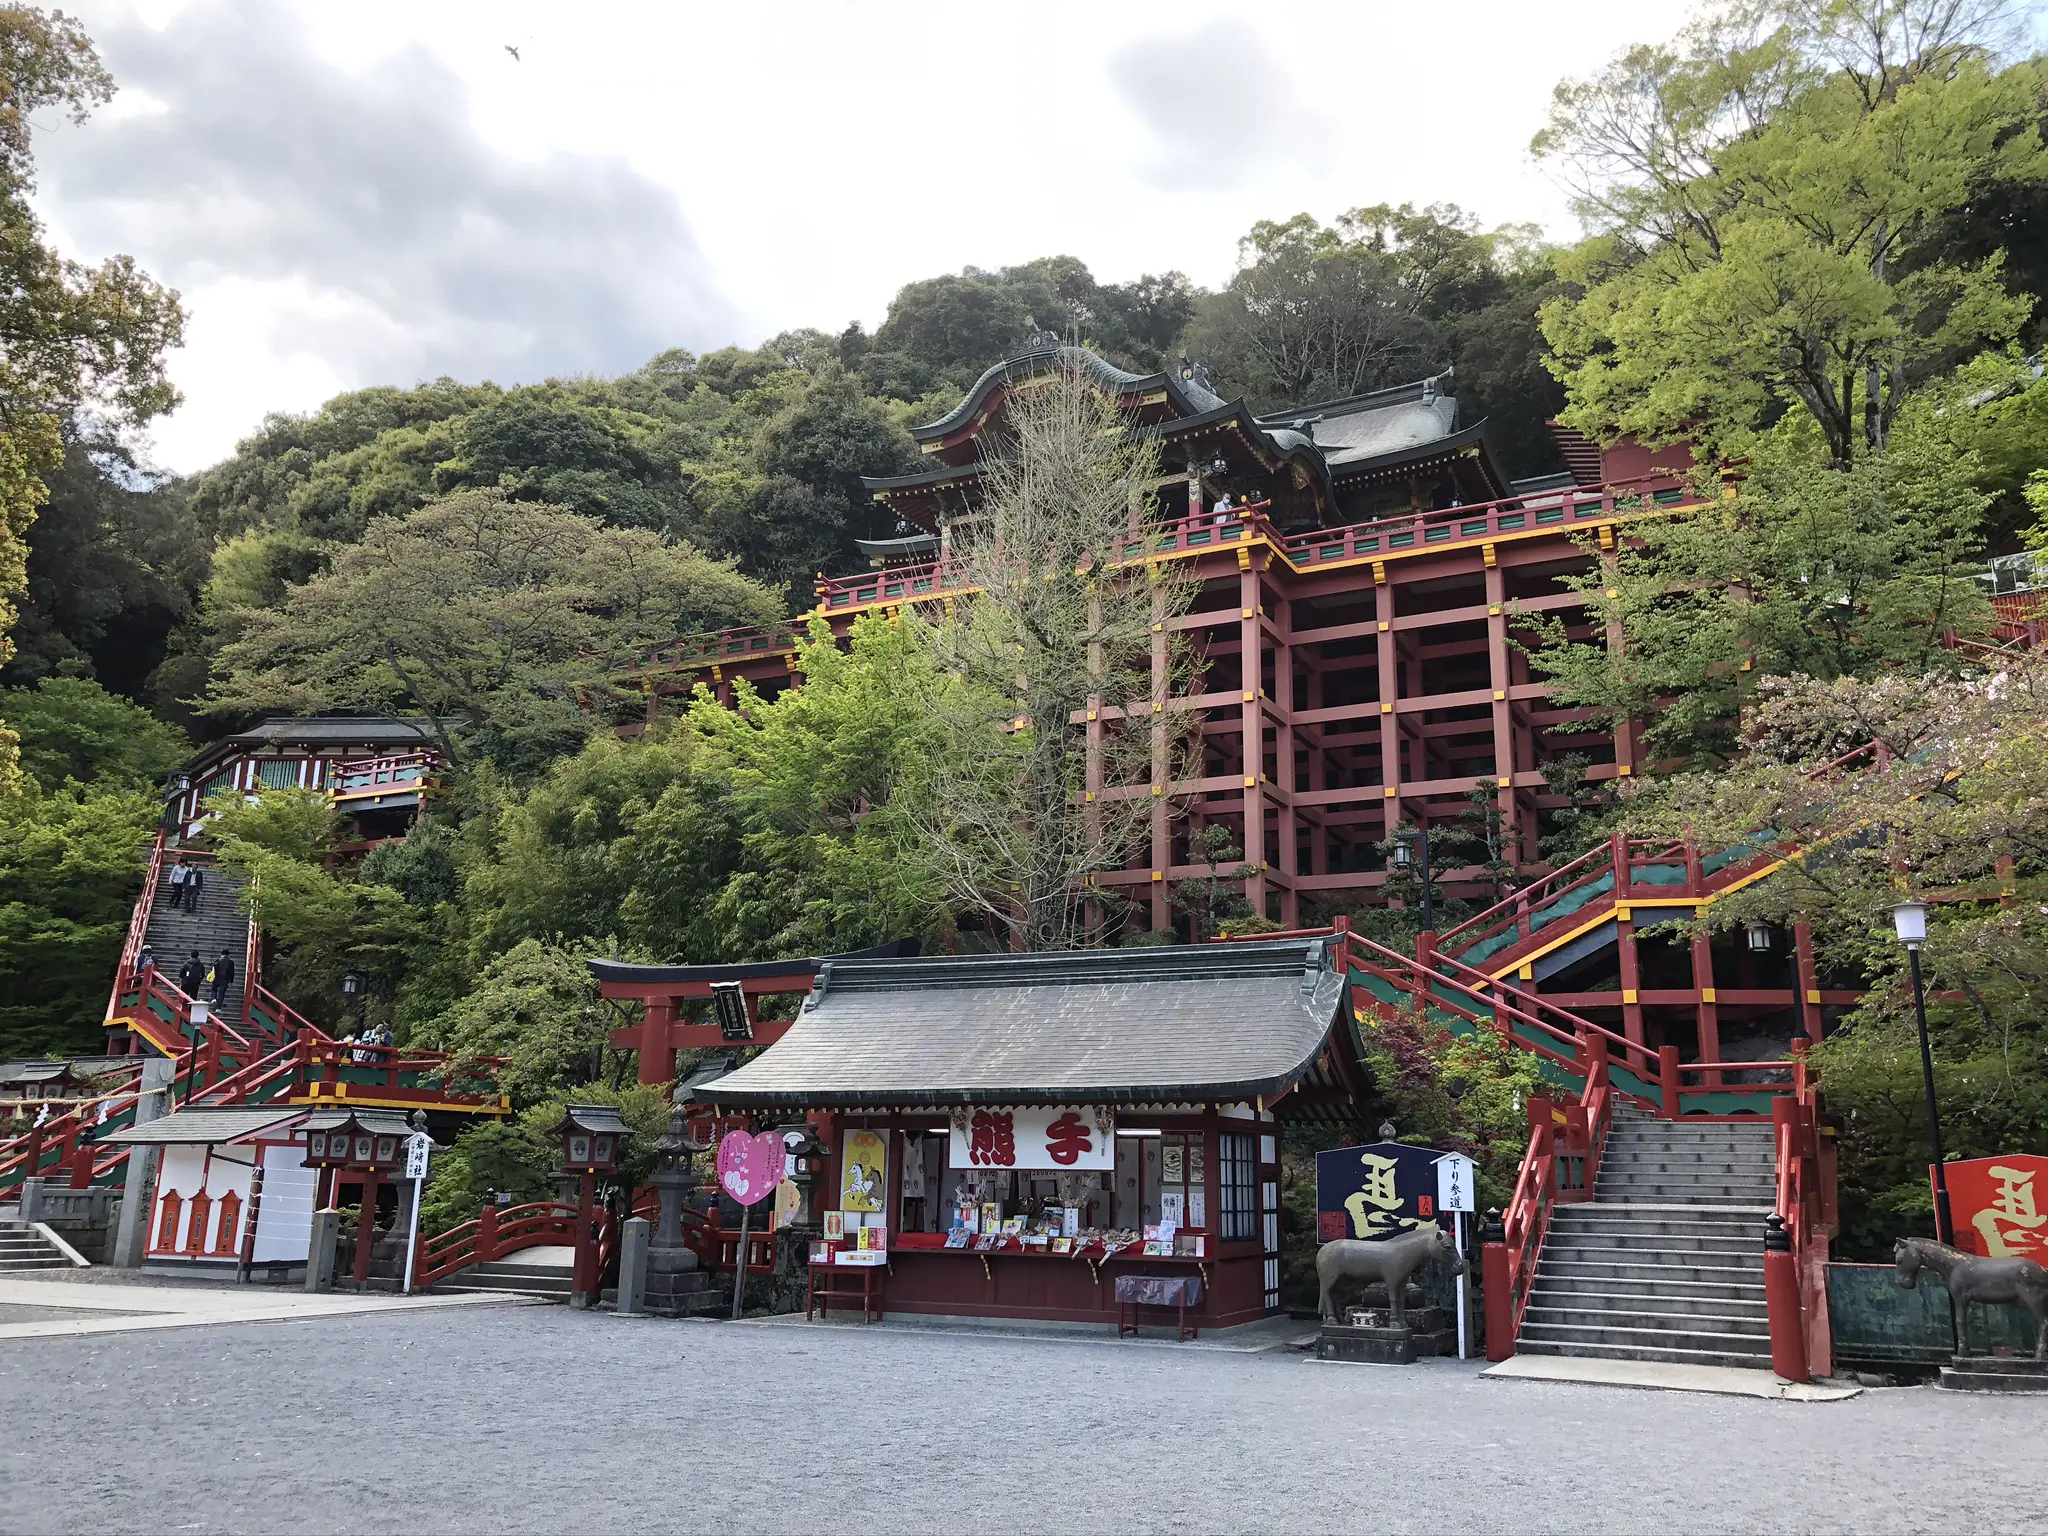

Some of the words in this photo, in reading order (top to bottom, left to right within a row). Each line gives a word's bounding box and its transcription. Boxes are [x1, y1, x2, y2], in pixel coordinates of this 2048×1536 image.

[969, 1109, 1093, 1166] 熊手
[1449, 1158, 1463, 1209] 下り参道
